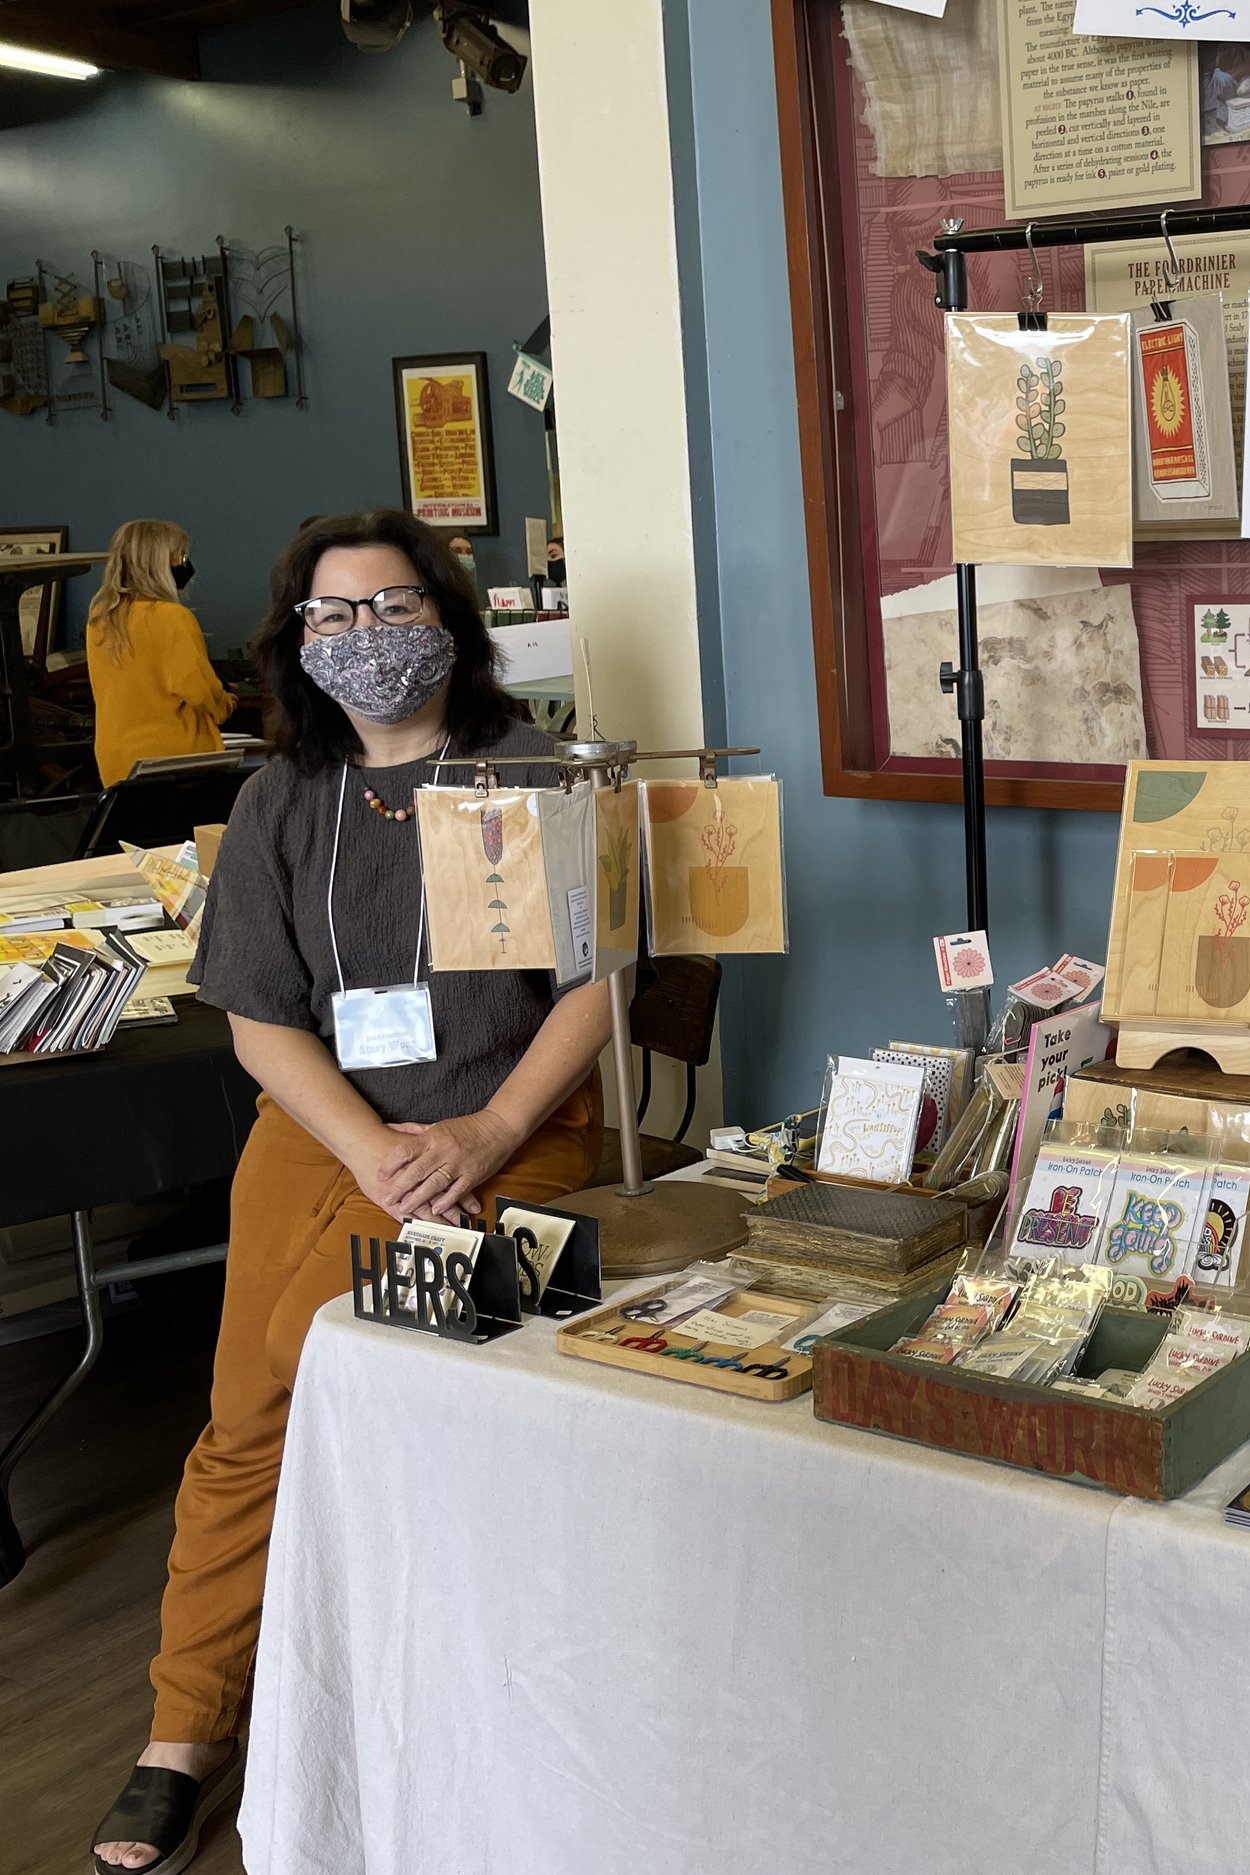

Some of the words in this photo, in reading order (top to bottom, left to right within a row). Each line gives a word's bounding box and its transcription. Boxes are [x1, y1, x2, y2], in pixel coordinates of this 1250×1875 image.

[1022, 77, 1049, 89] material
[1059, 74, 1083, 84] assume
[1084, 71, 1104, 83] many
[1105, 66, 1114, 77] of
[1113, 65, 1125, 76] the
[1126, 62, 1162, 77] properties
[1162, 58, 1172, 68] of
[1128, 262, 1150, 278] THE
[1177, 273, 1230, 292] MACHINE
[1142, 336, 1166, 351] ELECTRIC
[1168, 332, 1184, 345] LIGHT
[1044, 1028, 1072, 1048] Take
[1041, 1049, 1069, 1072] your
[1038, 1066, 1068, 1092] pick!
[1048, 1163, 1078, 1174] Iron-On
[1080, 1167, 1104, 1177] Patch
[1131, 1172, 1163, 1184] Iron-On
[1165, 1177, 1190, 1188] Patch
[350, 1234, 477, 1334] HERS
[1212, 1330, 1240, 1345] SARDINE
[1193, 1354, 1221, 1367] SARDINE
[971, 1392, 1138, 1490] WORK
